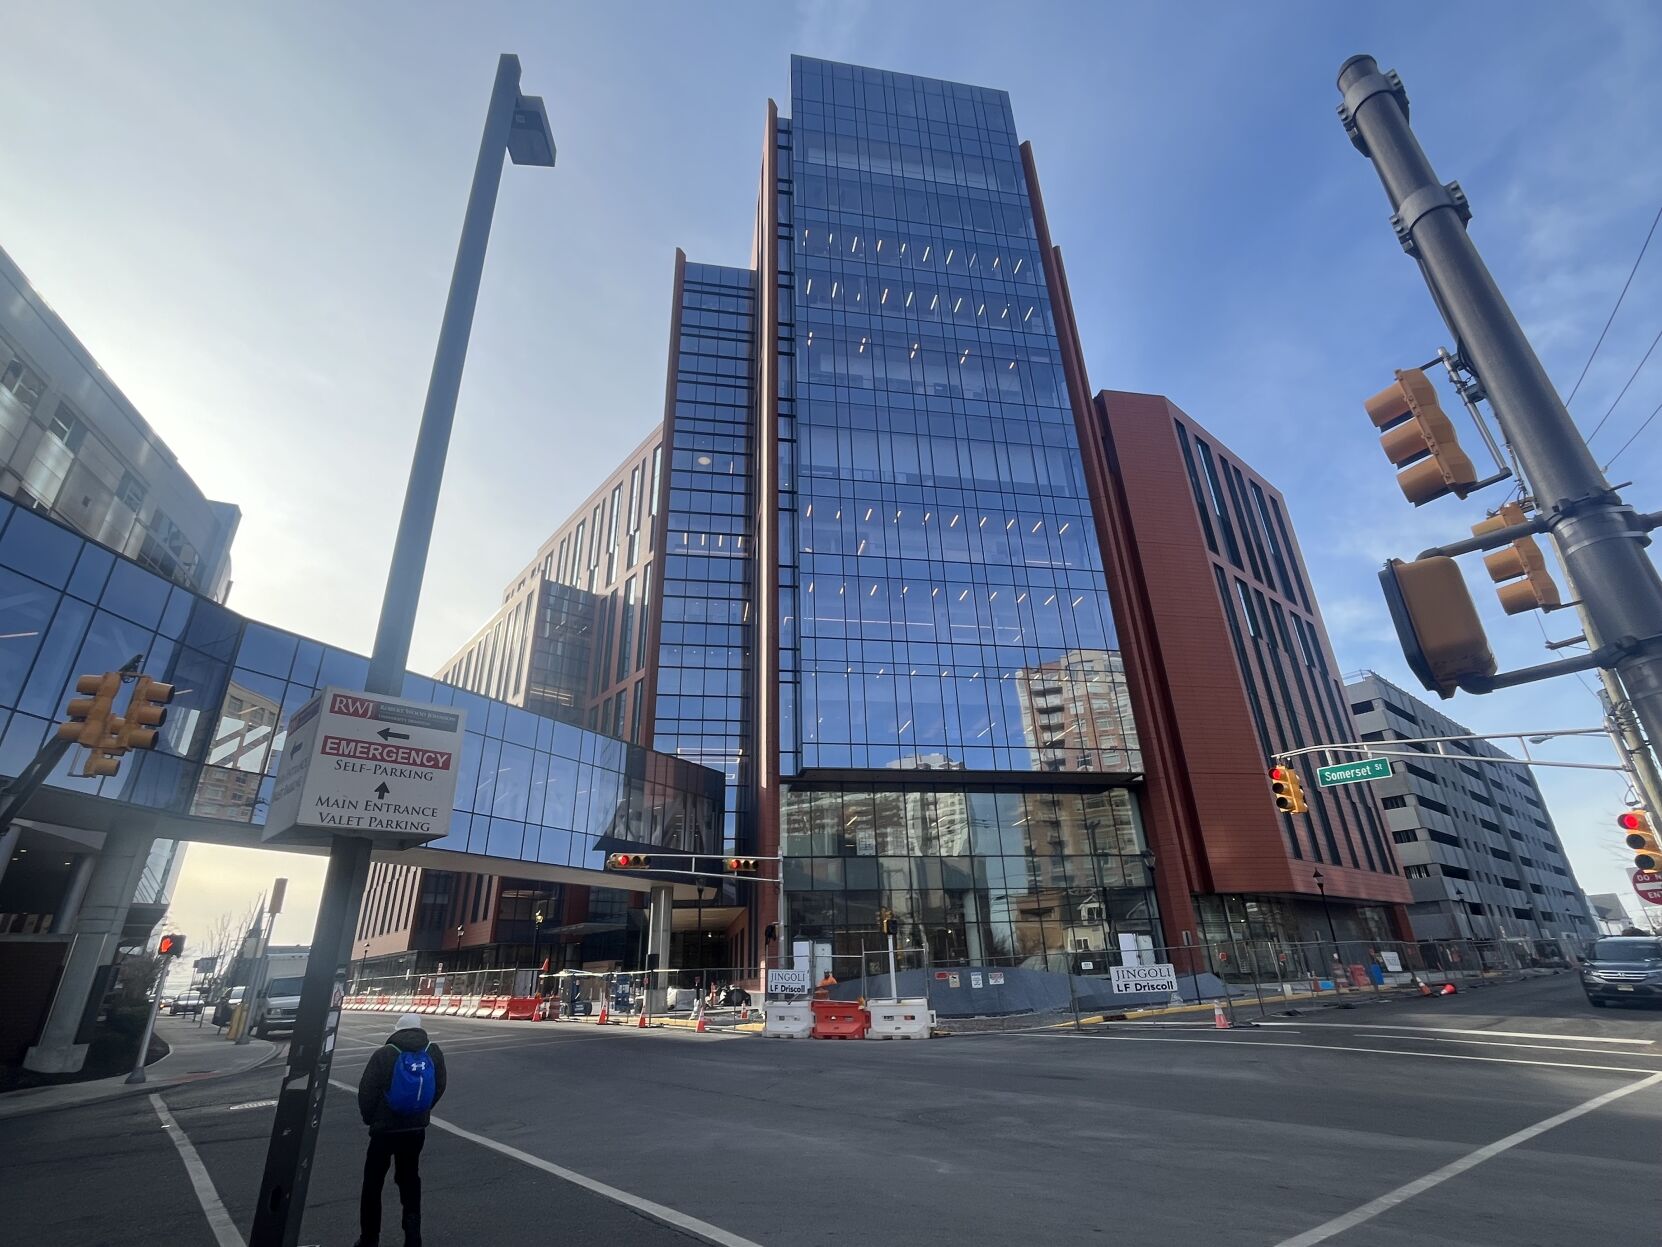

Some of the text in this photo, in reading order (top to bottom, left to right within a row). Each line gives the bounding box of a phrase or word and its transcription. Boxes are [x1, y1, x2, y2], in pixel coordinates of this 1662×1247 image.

[334, 697, 374, 719] RWJ
[325, 738, 449, 767] EMERGENCY
[334, 759, 434, 782] SELF-PARKING
[1324, 763, 1383, 782] Somerset St
[315, 795, 438, 818] MAIN ENTRANCE
[319, 811, 431, 832] VALET PARKING
[1636, 874, 1650, 882] DO
[770, 972, 805, 982] JINGOLI
[1115, 967, 1172, 981] JINGOLI
[770, 984, 779, 992] LF
[1116, 980, 1174, 993] LF Driscoll
